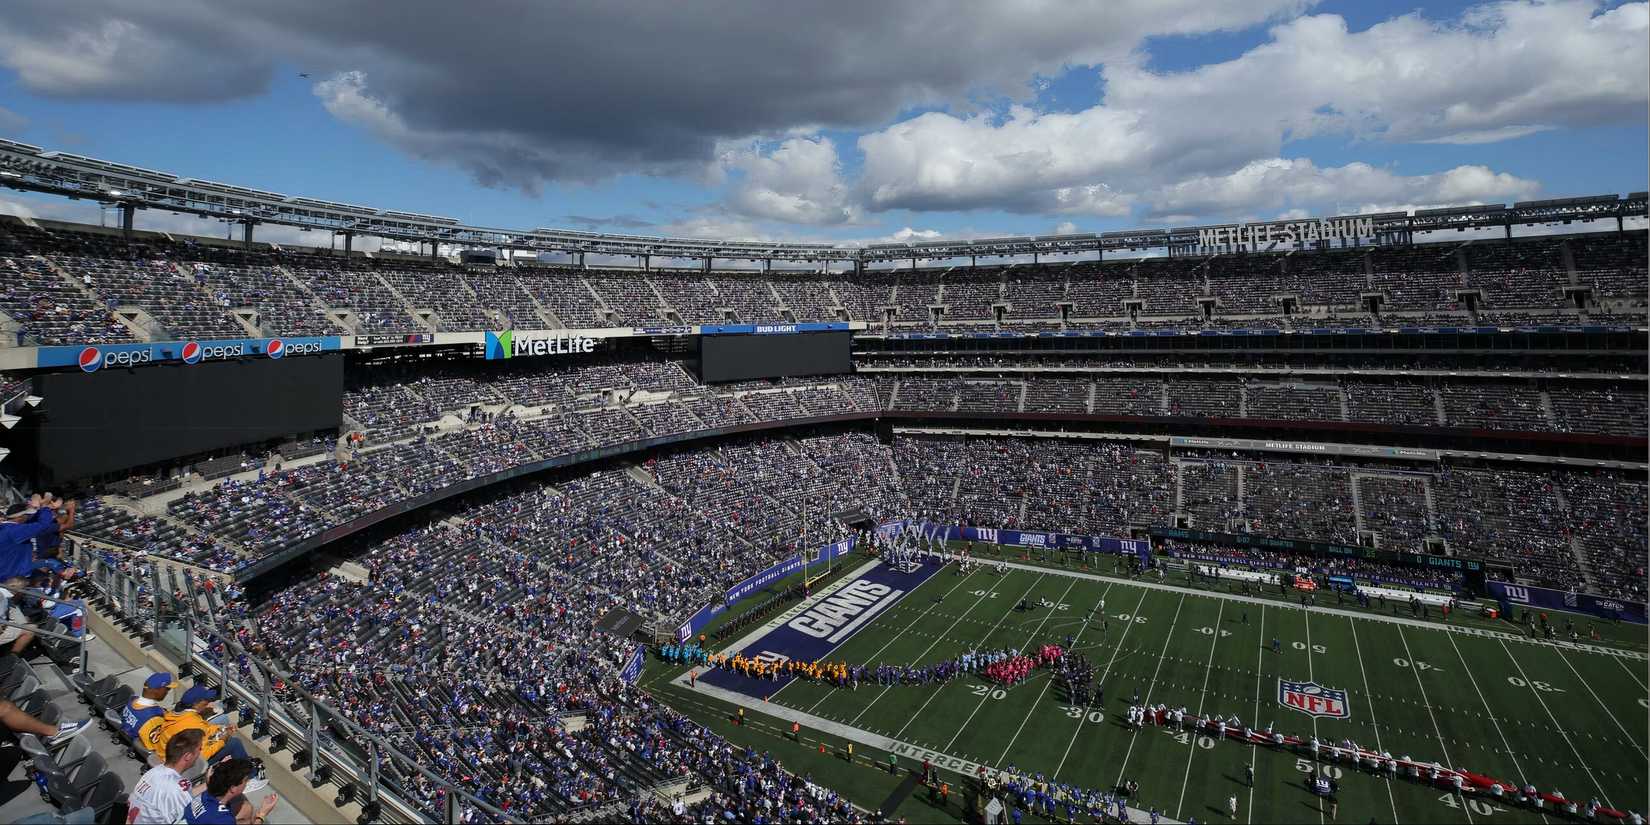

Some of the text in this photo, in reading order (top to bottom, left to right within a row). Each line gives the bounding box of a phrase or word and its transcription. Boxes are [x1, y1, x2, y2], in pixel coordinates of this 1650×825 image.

[1200, 218, 1373, 247] METLIFE STADIUM
[200, 343, 244, 361] pepsi
[284, 339, 322, 355] pepsi
[515, 335, 595, 356] MetLife
[104, 347, 153, 368] pepsi
[1019, 533, 1045, 545] GIANTS
[1429, 557, 1462, 568] GIANTS
[755, 570, 781, 586] FOOTBALL
[788, 579, 892, 639] GIANTS
[1287, 691, 1342, 714] NFL
